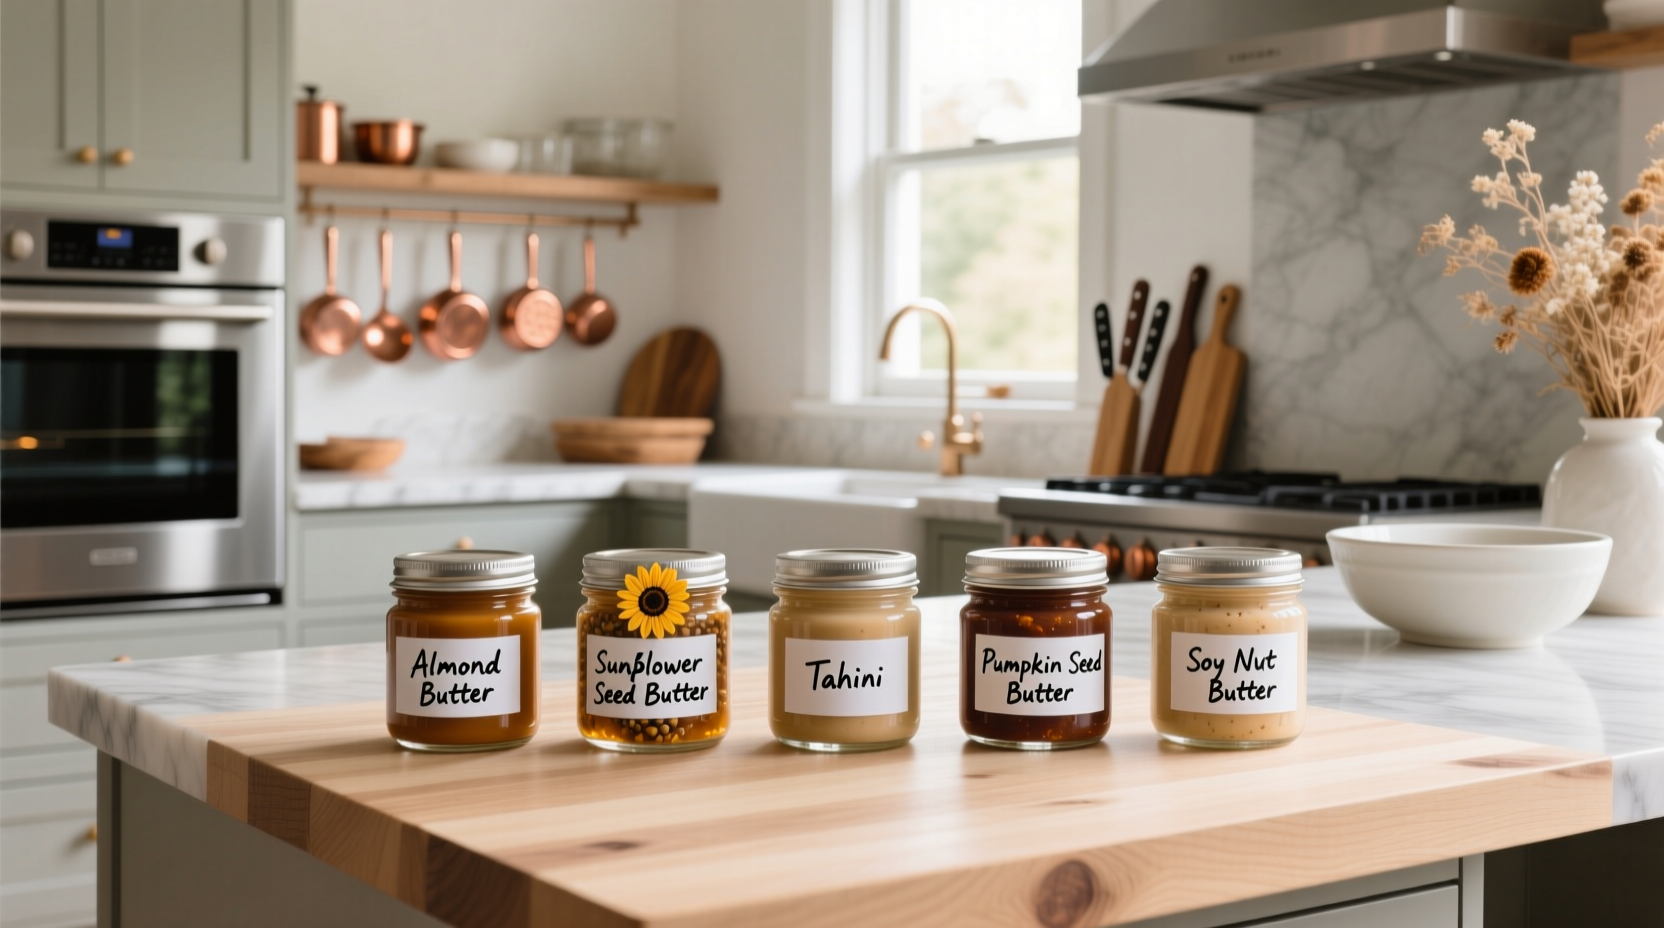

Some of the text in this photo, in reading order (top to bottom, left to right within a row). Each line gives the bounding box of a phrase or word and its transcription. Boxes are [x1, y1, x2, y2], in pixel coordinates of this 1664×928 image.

[409, 648, 502, 679] Almond
[804, 659, 884, 691] Tahini
[982, 647, 1102, 683] Pumpkin Seed
[1186, 646, 1277, 681] Soy Nut
[419, 680, 495, 708] Butter
[593, 680, 709, 707] Seed Butter
[1006, 680, 1074, 705] Butter
[1208, 679, 1277, 703] Butter
